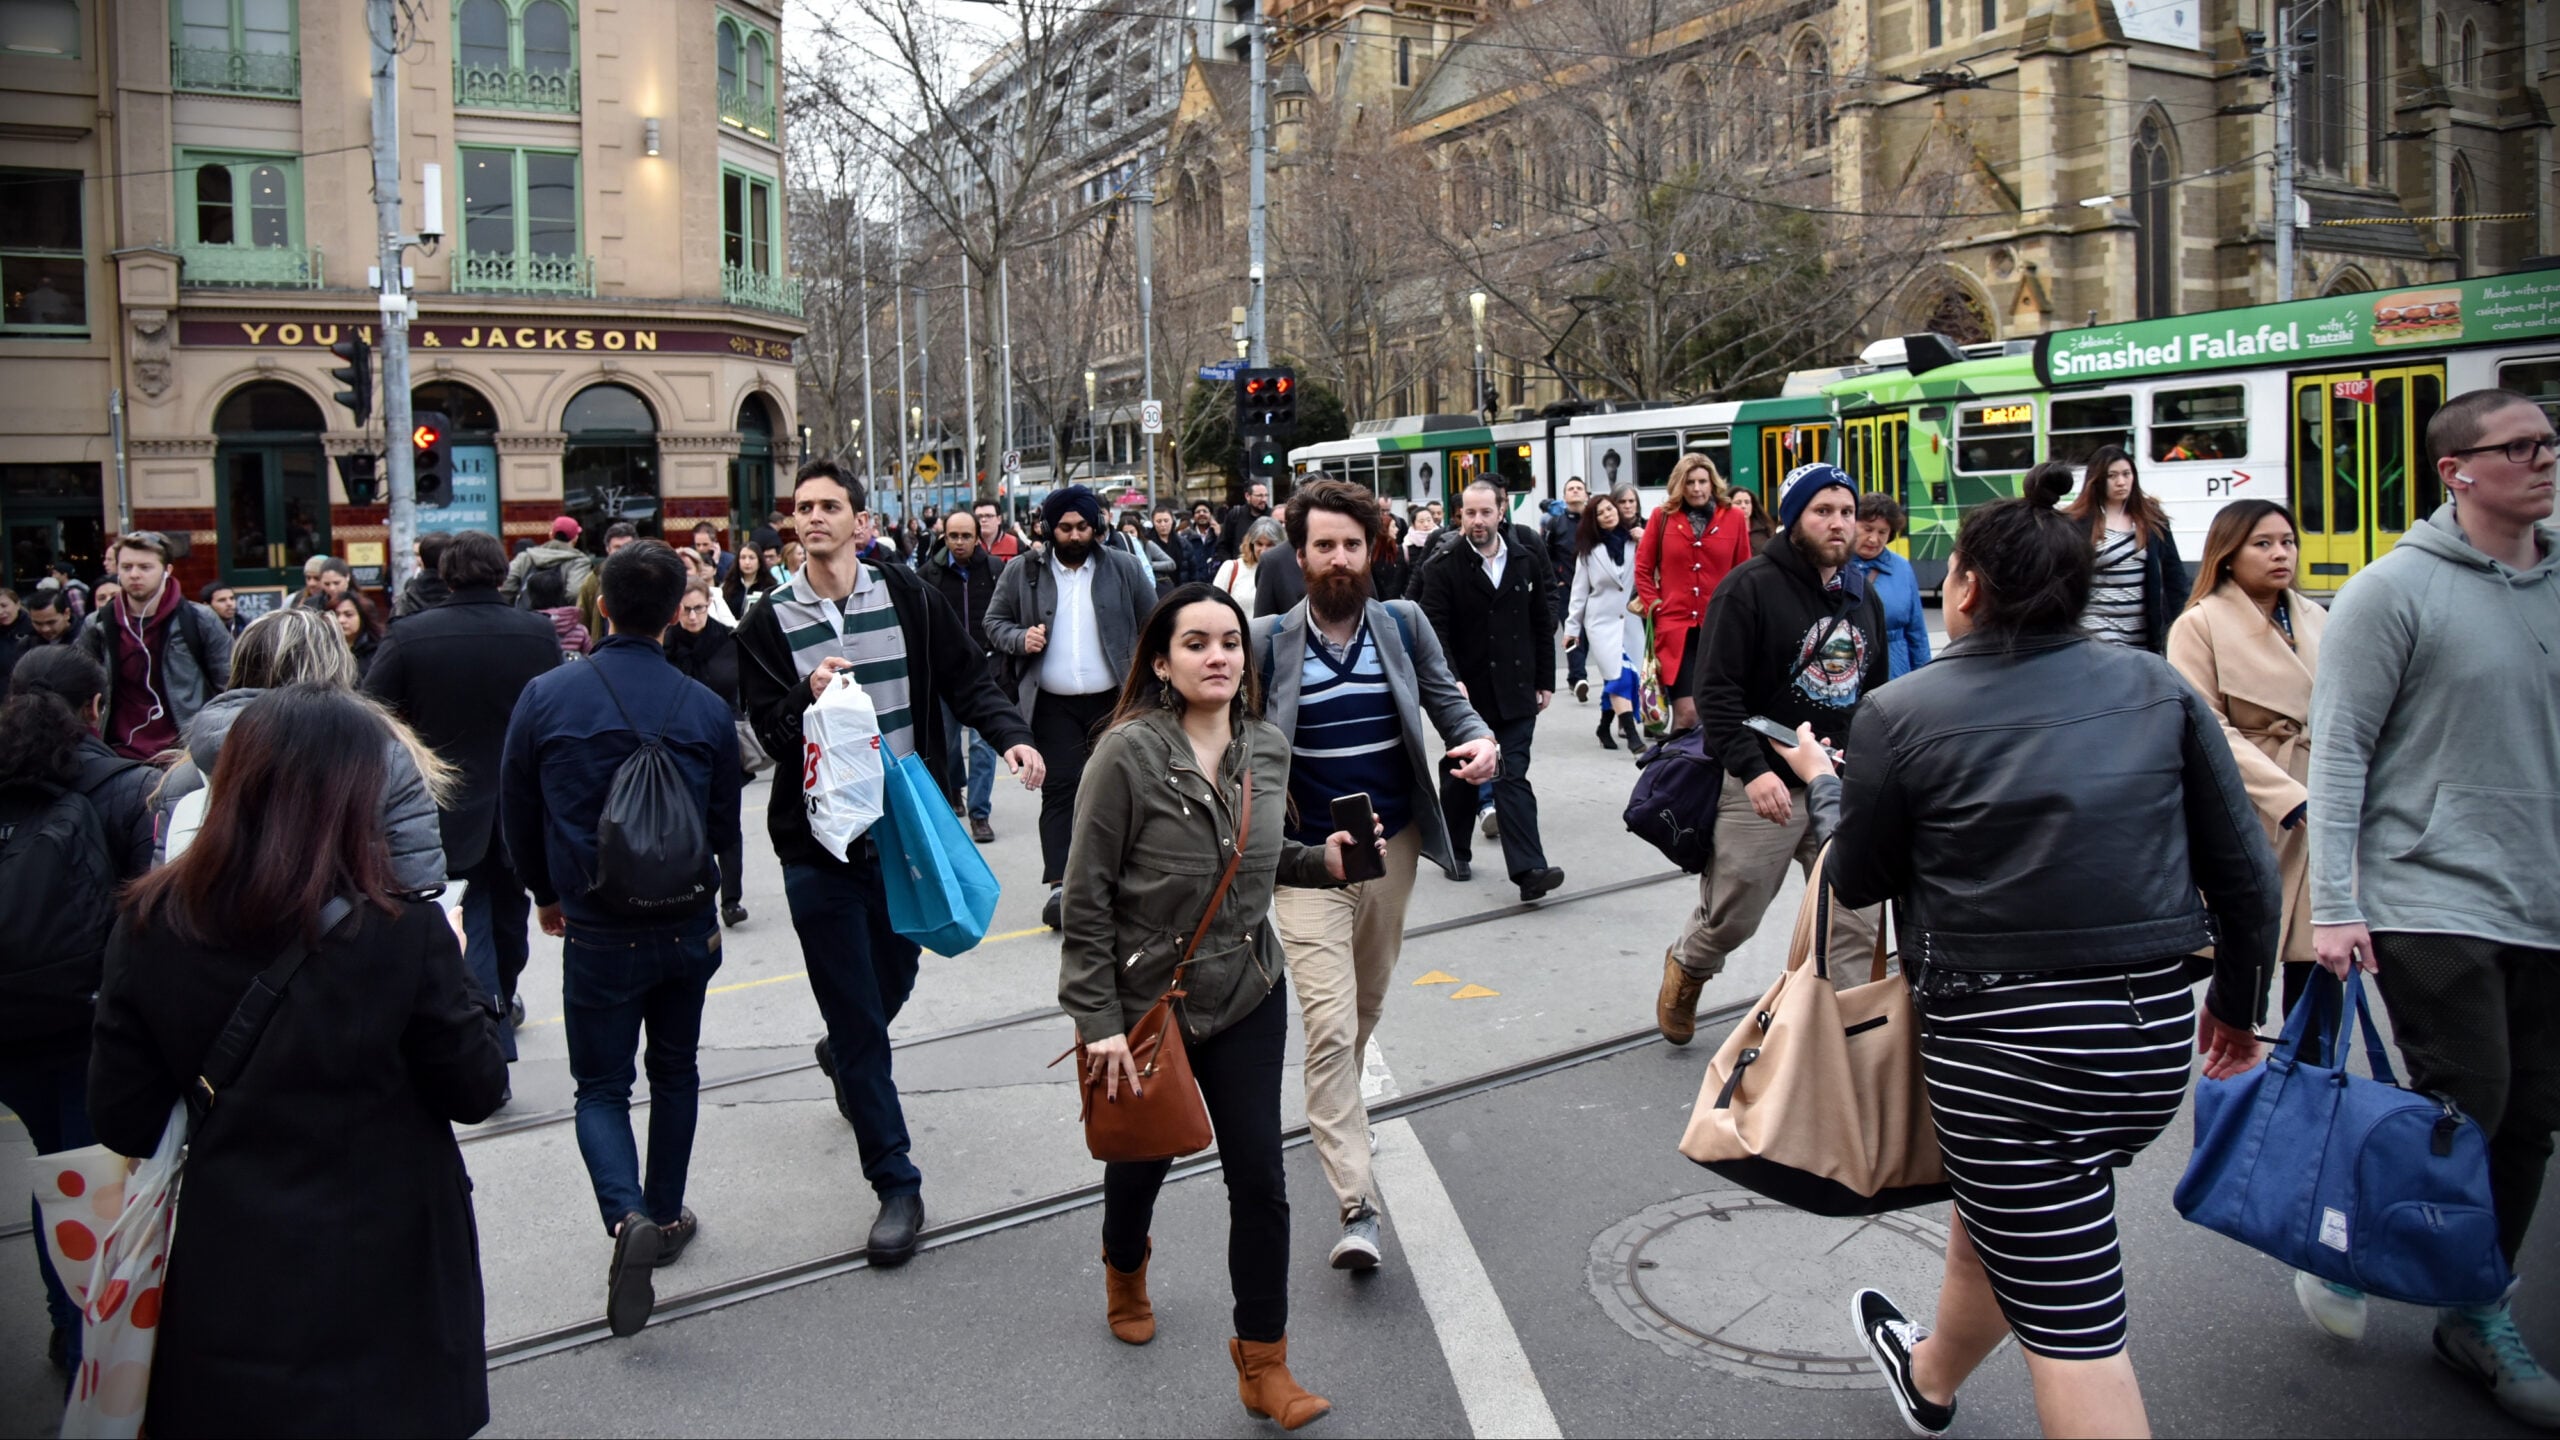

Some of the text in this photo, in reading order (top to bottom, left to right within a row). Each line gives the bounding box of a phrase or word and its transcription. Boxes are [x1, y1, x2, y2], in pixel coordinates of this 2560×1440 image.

[2317, 317, 2344, 331] with
[423, 331, 440, 347] &
[461, 327, 657, 350] JACKSON
[2078, 334, 2115, 349] delicious
[2306, 329, 2354, 344] Tzatziki
[2052, 321, 2300, 376] Smashed Falafel
[2335, 380, 2368, 396] STOP
[1145, 411, 1159, 423] 30
[416, 511, 488, 523] OFFEE
